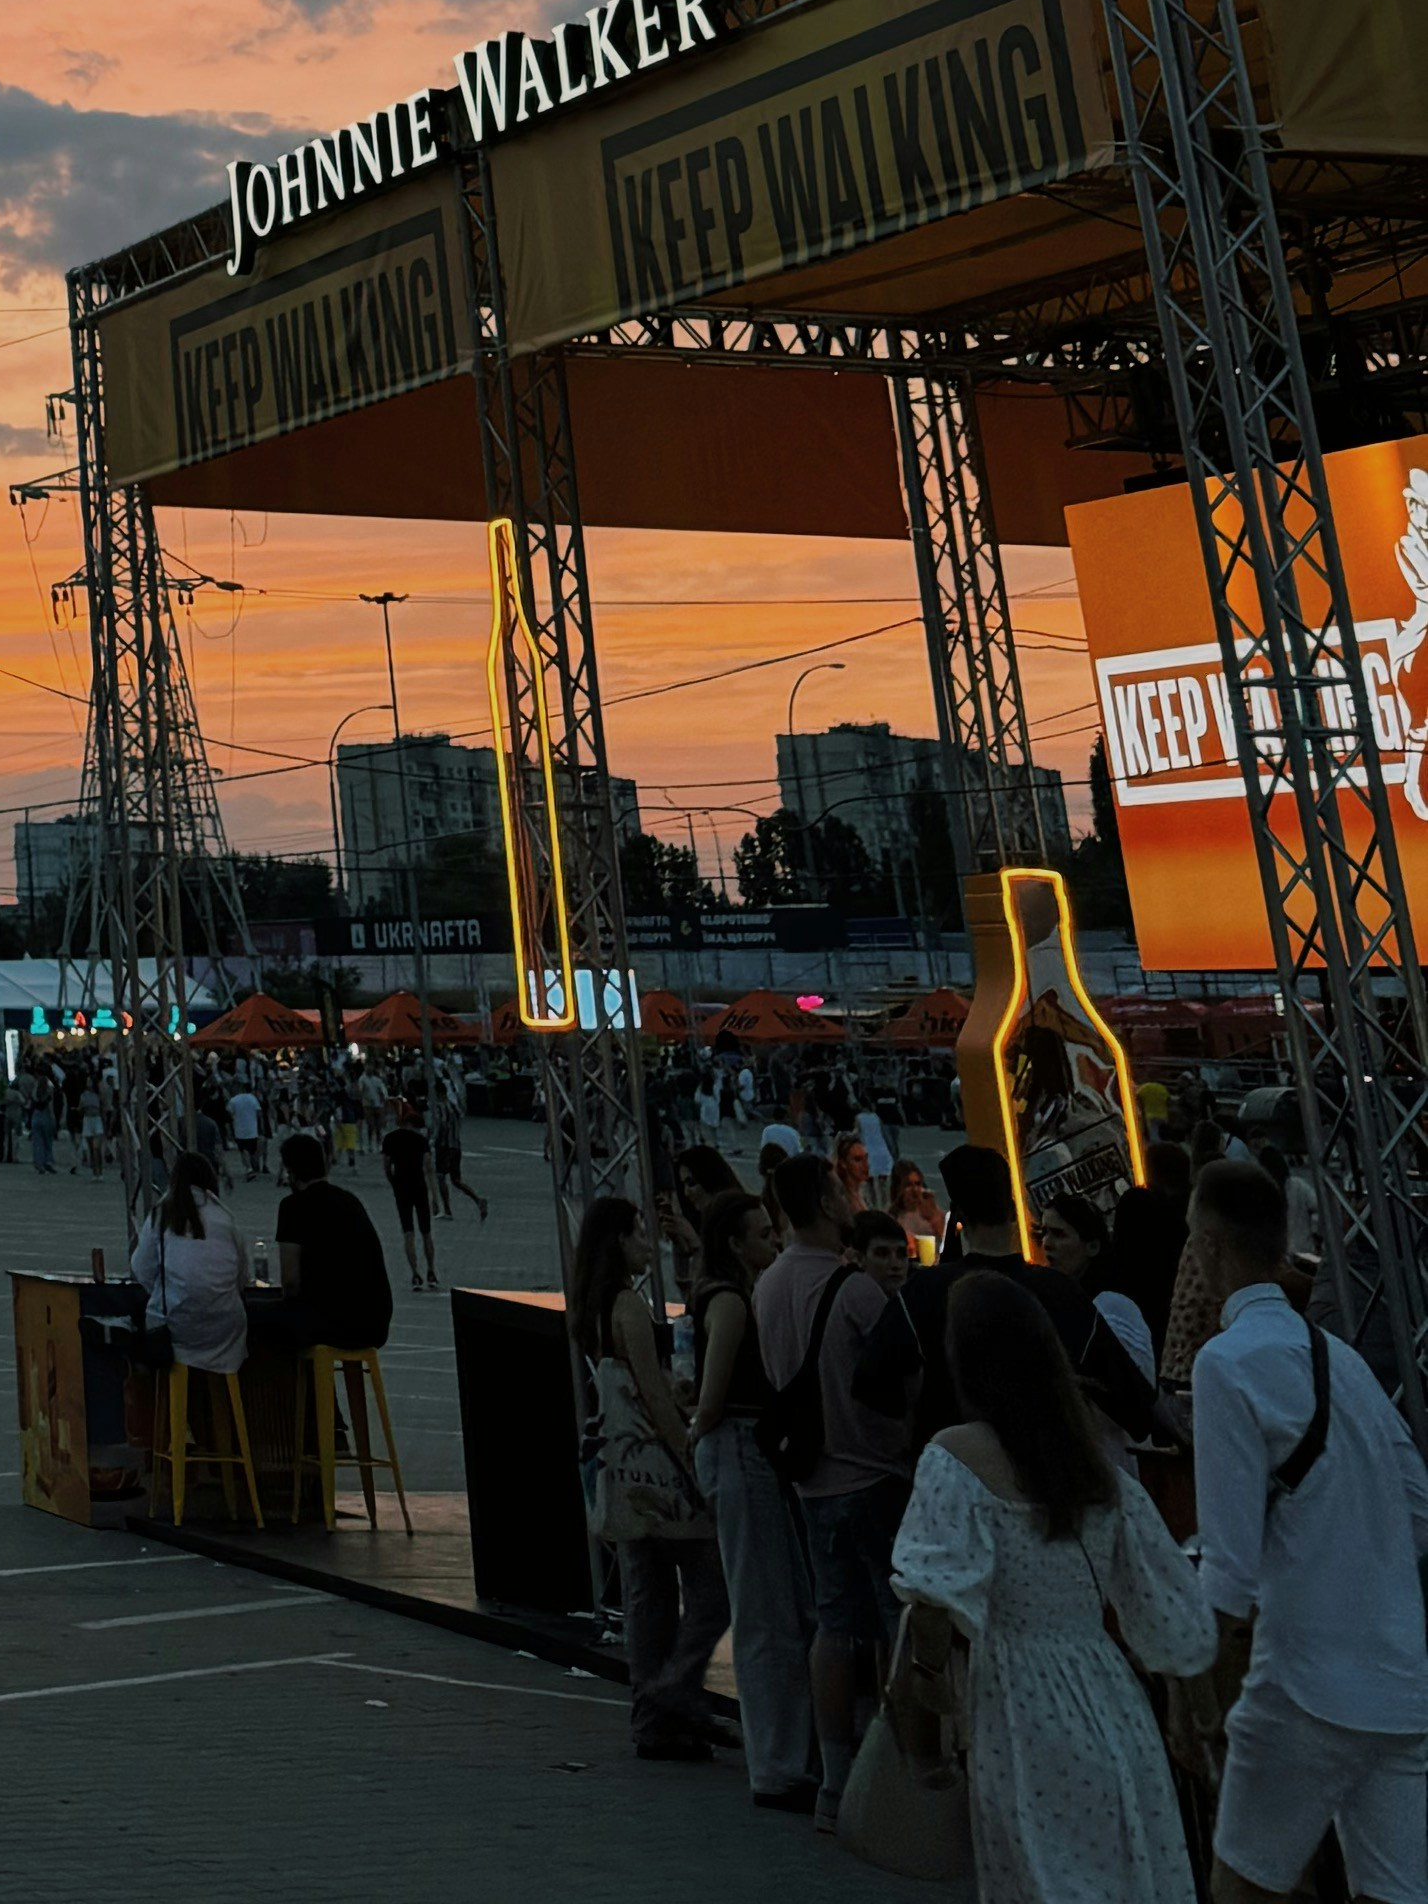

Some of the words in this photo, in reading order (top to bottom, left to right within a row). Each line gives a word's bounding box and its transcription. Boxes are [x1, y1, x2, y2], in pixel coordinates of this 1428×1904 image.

[225, 88, 439, 277] JOHNNIE
[622, 137, 754, 311] KEEP
[758, 23, 1055, 266] WALKING
[182, 317, 266, 456] KEEP
[266, 255, 440, 416] WALKING
[1113, 675, 1208, 778] KEEP
[607, 1468, 684, 1489] ITUALS
